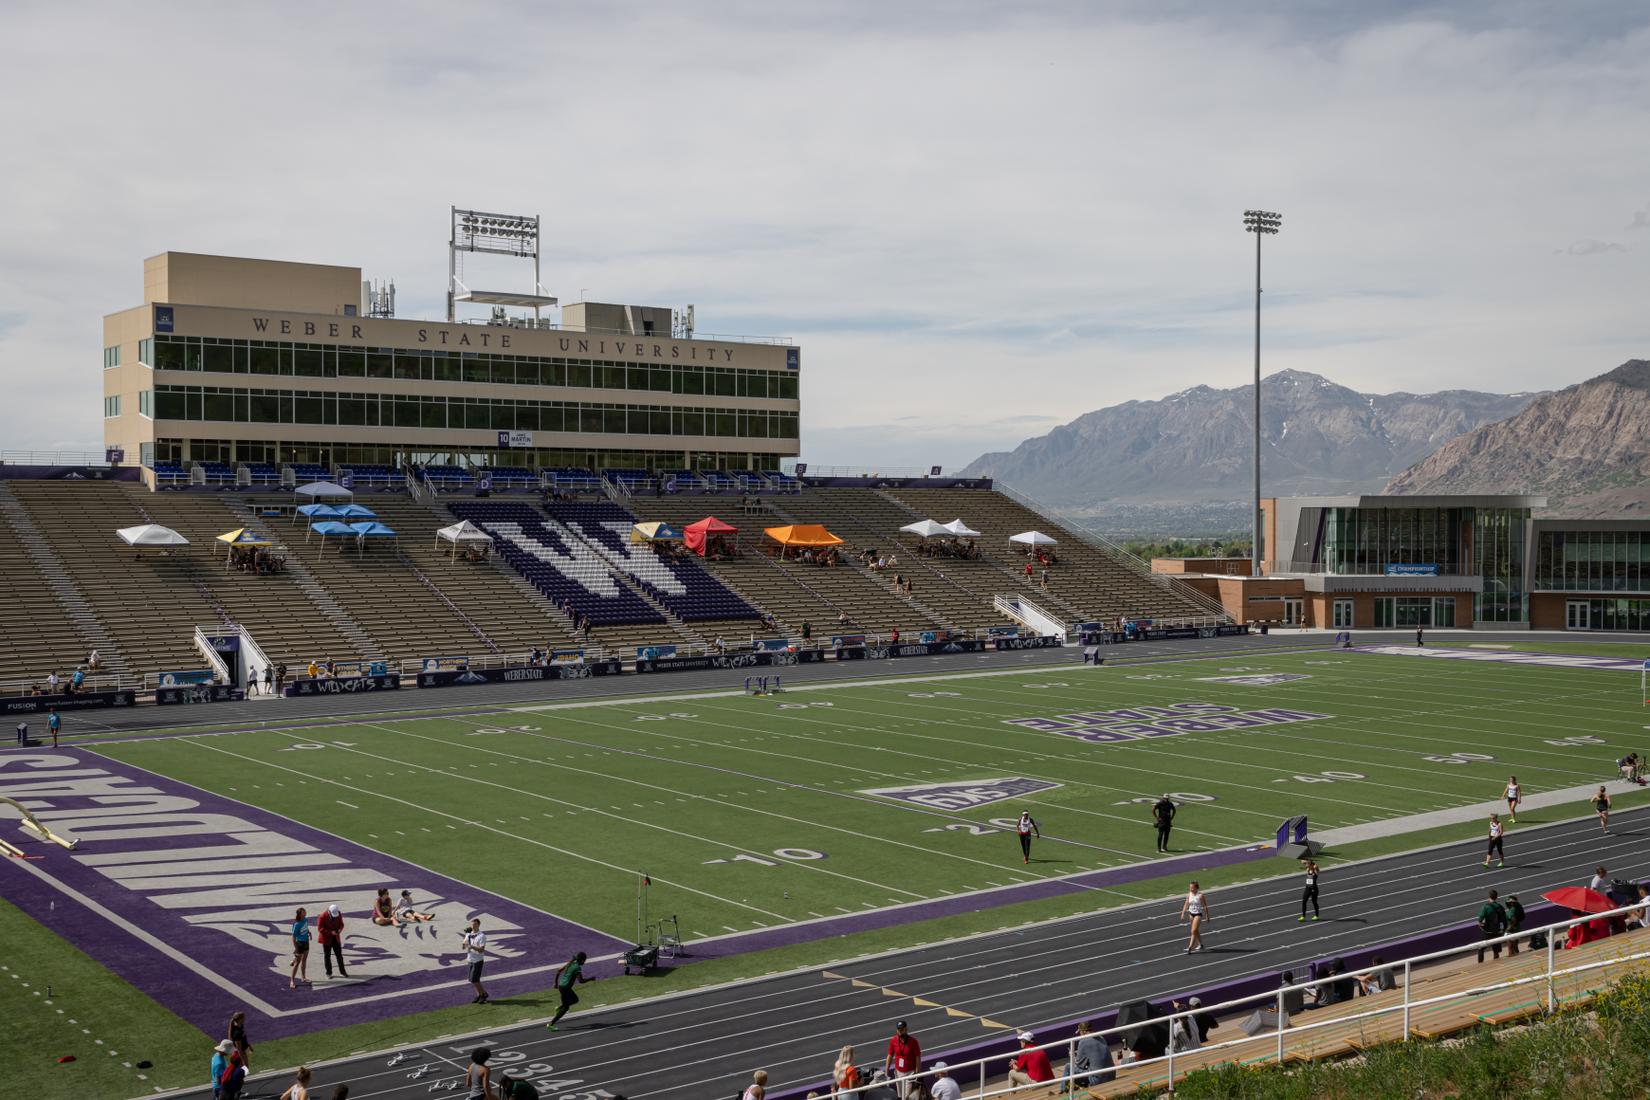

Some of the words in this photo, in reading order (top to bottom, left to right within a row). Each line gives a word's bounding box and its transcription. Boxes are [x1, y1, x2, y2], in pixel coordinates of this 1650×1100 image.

[253, 318, 363, 339] WEBER
[418, 329, 512, 348] STATE
[559, 338, 735, 362] UNIVERSITY
[500, 434, 509, 443] 10
[111, 452, 119, 461] F
[342, 477, 349, 487] E
[481, 480, 489, 490] D
[667, 481, 674, 490] C
[482, 522, 687, 597] W
[504, 671, 525, 681] WEBER
[525, 669, 544, 680] STATE
[317, 678, 376, 693] WILDCATS
[7, 702, 37, 710] FUSION
[1000, 702, 1240, 732] STATE
[1048, 707, 1336, 744] WEBER
[1420, 752, 1494, 764] 50
[1292, 771, 1365, 783] 40
[905, 788, 1009, 808] SKY
[732, 848, 824, 866] 10
[450, 1039, 499, 1054] 1
[486, 1050, 527, 1066] 2
[502, 1063, 554, 1079] 3
[535, 1078, 585, 1093] 4
